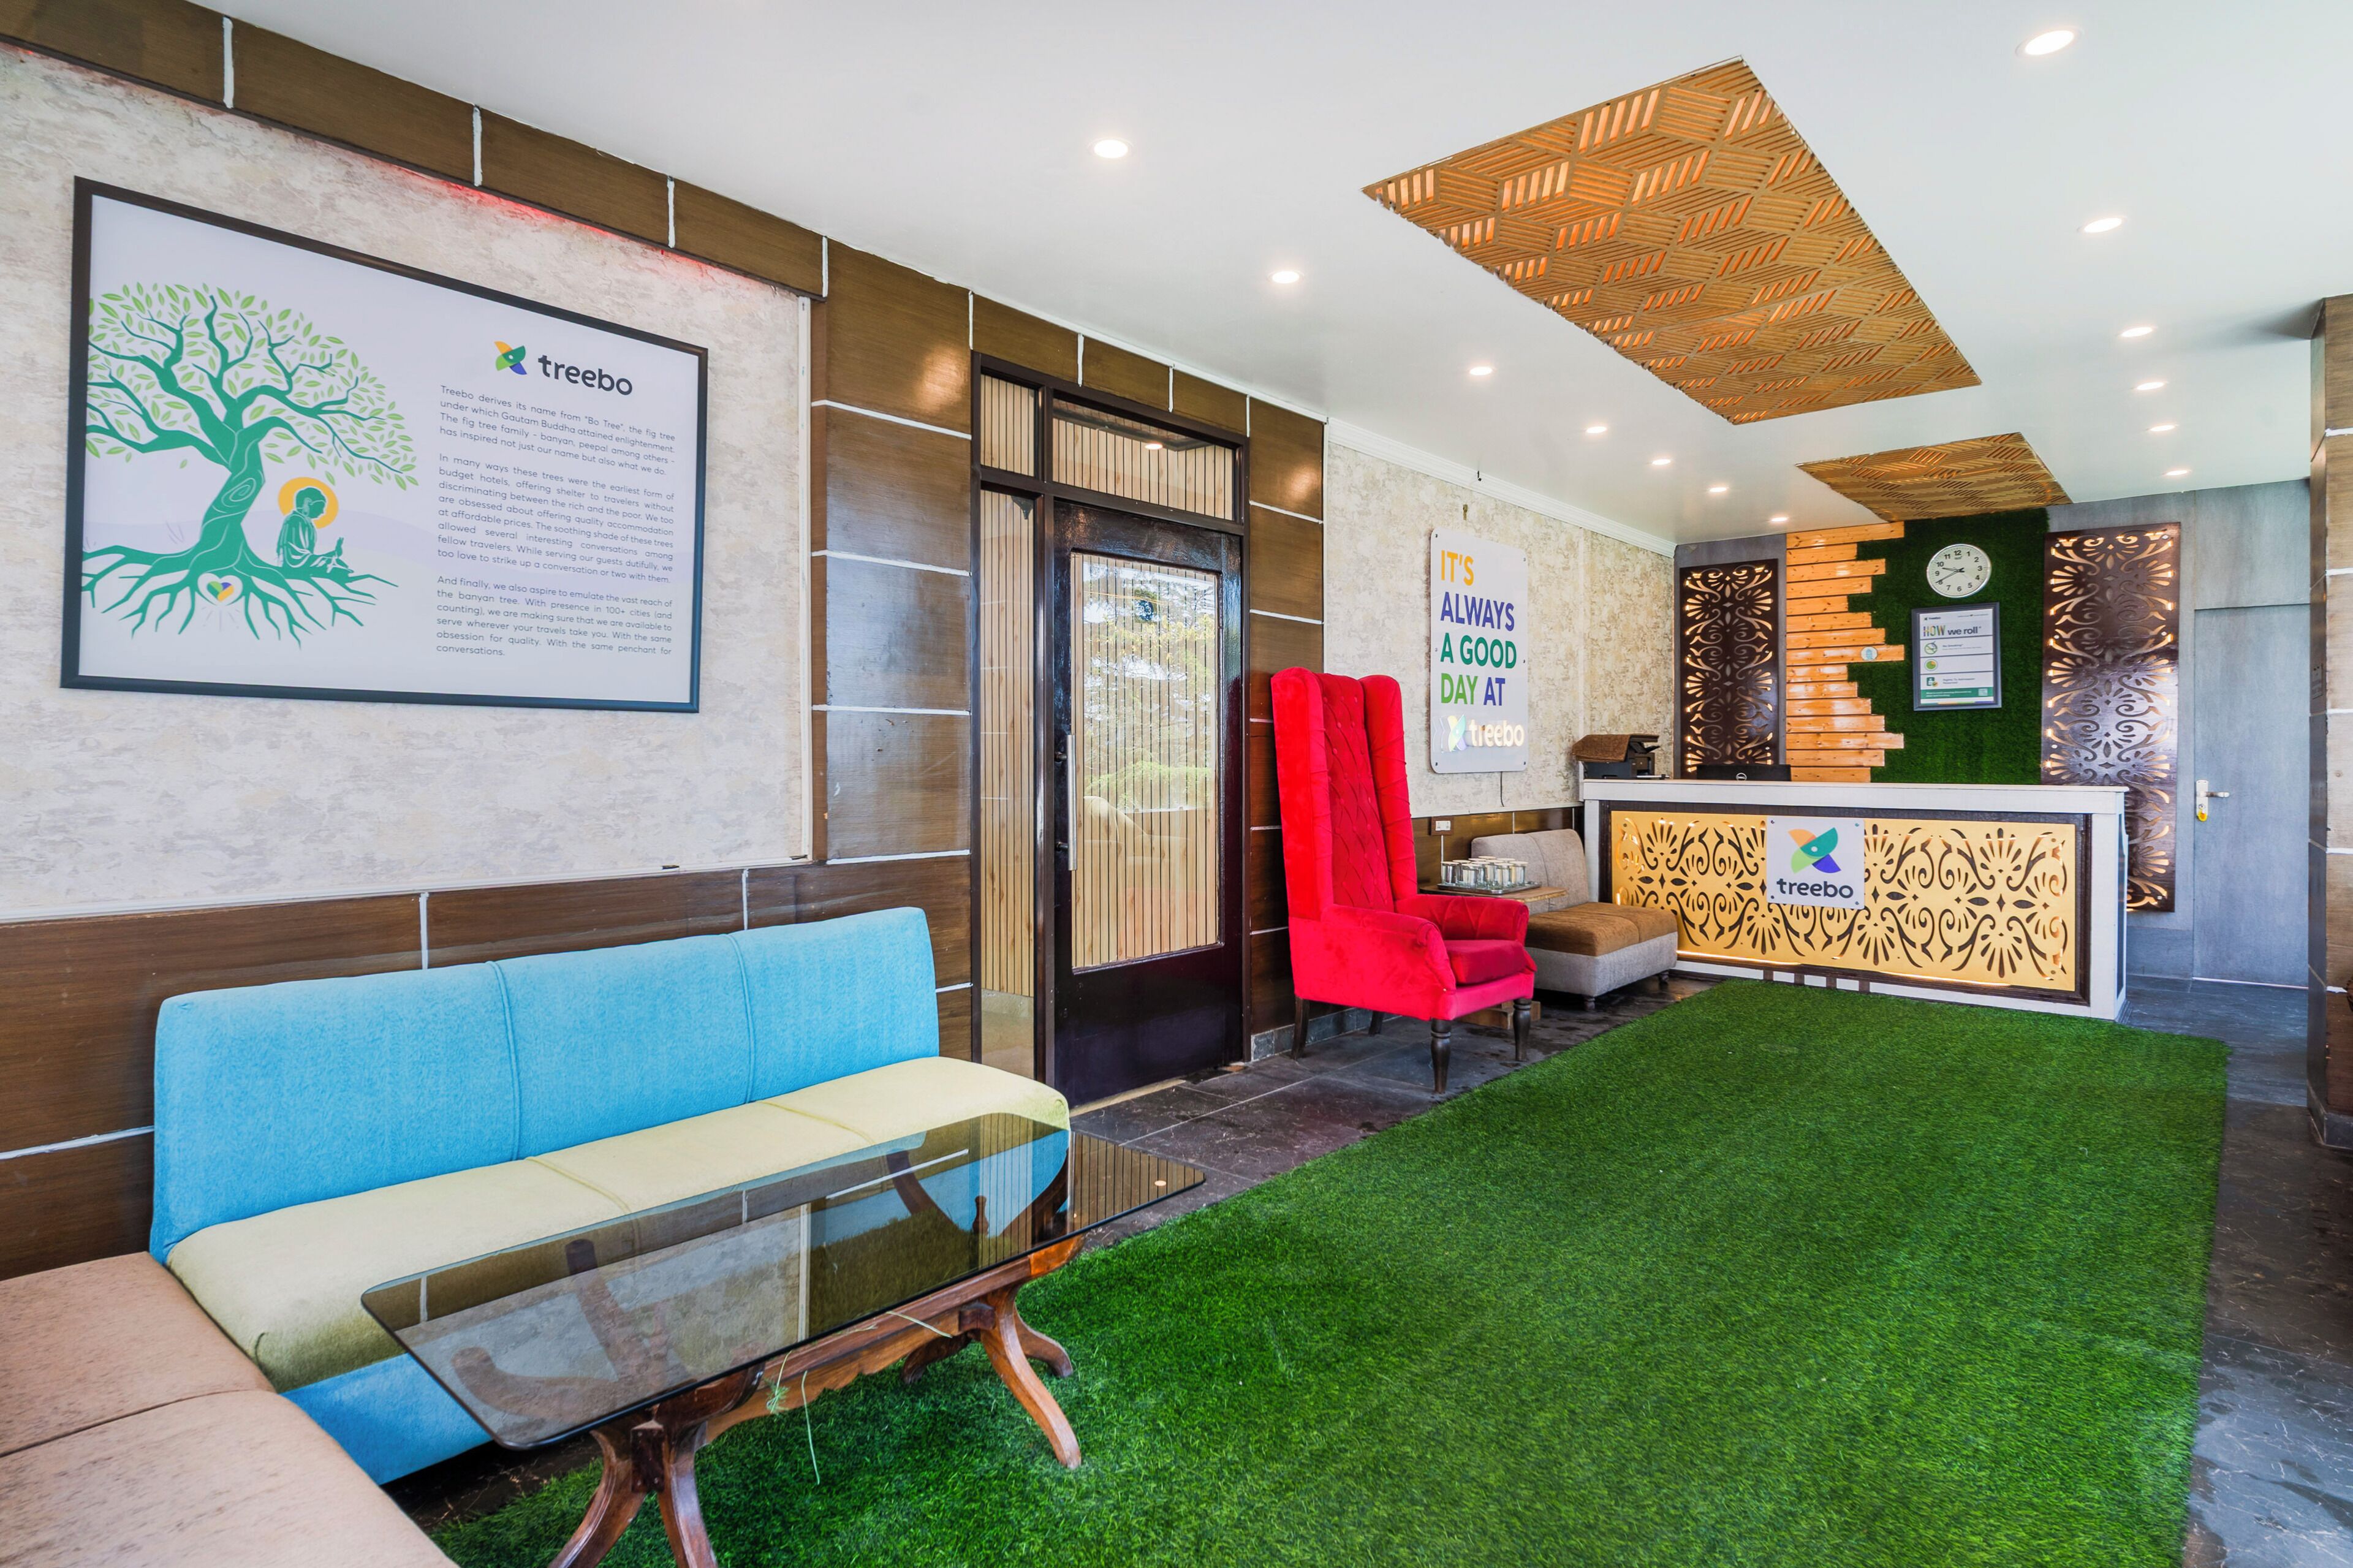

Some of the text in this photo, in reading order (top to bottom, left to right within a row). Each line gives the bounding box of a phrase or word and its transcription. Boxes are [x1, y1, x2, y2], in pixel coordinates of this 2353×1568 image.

[538, 355, 632, 395] treebo
[439, 384, 474, 400] Treebo
[477, 393, 512, 407] derives
[515, 401, 528, 412] its
[530, 406, 556, 417] name
[559, 410, 581, 422] from
[628, 425, 642, 435] the
[645, 428, 656, 439] fig
[659, 431, 675, 441] tree
[439, 400, 469, 412] under
[471, 406, 499, 419] which
[501, 411, 540, 426] Gautam
[540, 419, 576, 434] Buddha
[577, 428, 613, 441] attained
[439, 411, 458, 423] The
[460, 416, 475, 428] fig
[478, 420, 498, 431] tree
[500, 423, 529, 439] family
[578, 441, 608, 452] peepal
[610, 447, 640, 460] among
[642, 453, 669, 464] others
[439, 425, 458, 437] has
[460, 430, 498, 444] inspired
[500, 439, 517, 448] not
[517, 441, 535, 452] just
[554, 449, 580, 460] name
[581, 452, 597, 463] but
[597, 456, 616, 466] also
[617, 460, 638, 471] what
[439, 466, 474, 480] budget
[515, 480, 551, 494] offering
[556, 487, 586, 498] shelter
[604, 494, 640, 507] travelers
[643, 501, 674, 513] without
[453, 457, 662, 499] many ways these trees were the earliest form
[438, 480, 507, 501] discriminating
[509, 491, 549, 505] between
[550, 498, 566, 508] the
[568, 501, 585, 510] rich
[605, 507, 621, 517] the
[644, 513, 659, 522] We
[660, 515, 674, 525] too
[458, 497, 503, 511] obsessed
[506, 504, 534, 516] about
[536, 509, 572, 523] offering
[574, 516, 604, 528] quality
[606, 521, 674, 536] accommodation
[438, 521, 673, 562] allowed several interesting conversations among
[450, 509, 502, 524] affordable
[534, 521, 553, 531] The
[553, 526, 592, 539] soothing
[593, 530, 619, 540] shade
[630, 535, 653, 545] these
[653, 539, 673, 548] trees
[437, 548, 455, 558] too
[457, 550, 477, 561] love
[491, 555, 517, 566] strike
[542, 562, 598, 575] conversation
[610, 570, 627, 578] two
[438, 534, 467, 546] fellow
[515, 544, 543, 556] While
[544, 550, 577, 562] serving
[596, 556, 623, 566] guests
[1441, 550, 1474, 586] IT'S
[436, 575, 458, 585] And
[507, 583, 528, 593] also
[529, 587, 557, 596] aspire
[569, 591, 605, 600] emulate
[605, 593, 620, 602] the
[436, 588, 453, 599] the
[458, 590, 494, 603] banyan
[524, 597, 546, 608] With
[550, 602, 589, 612] presence
[605, 605, 626, 615] 100+
[629, 608, 651, 618] cities
[653, 610, 672, 619] (and
[520, 611, 555, 623] making
[576, 615, 594, 624] that
[624, 621, 662, 631] available
[1441, 591, 1514, 631] ALWAYS
[436, 618, 463, 626] serve
[466, 618, 510, 630] wherever
[536, 625, 566, 635] travels
[569, 627, 588, 637] take
[611, 631, 632, 640] With
[634, 632, 648, 642] the
[436, 629, 484, 641] obsession
[490, 633, 504, 643] for
[546, 638, 567, 647] With
[571, 640, 586, 649] the
[617, 645, 656, 654] penchant
[1923, 624, 1946, 637] HOW
[1441, 632, 1517, 668] A GOOD
[1441, 673, 1506, 706] DAY AT
[1469, 719, 1524, 746] treebo
[1776, 878, 1854, 898] treebo
